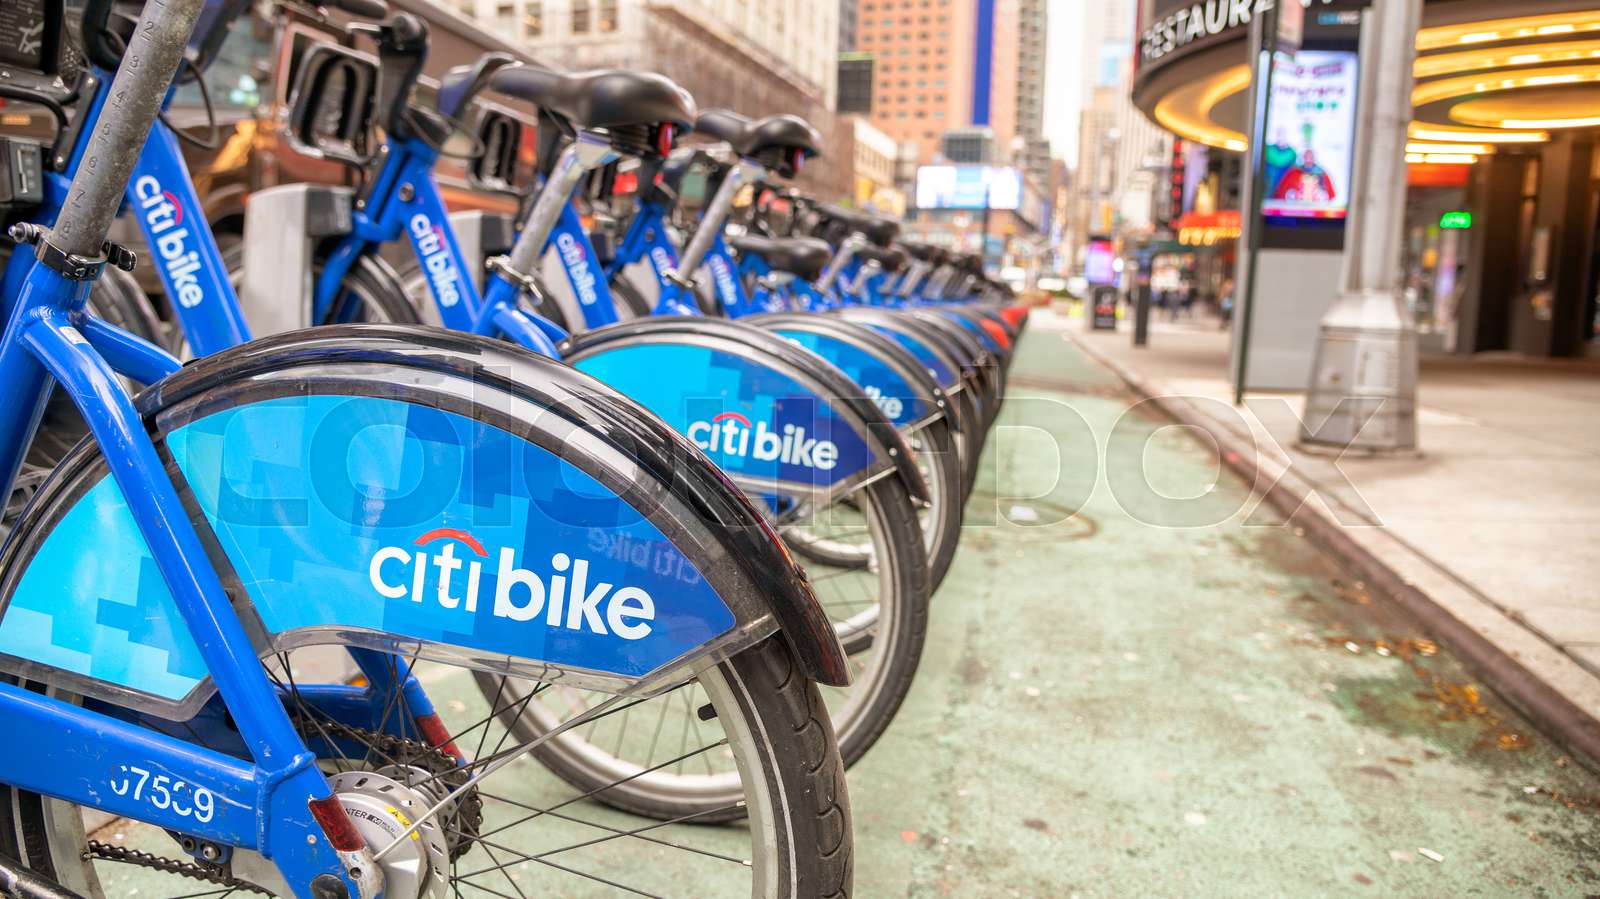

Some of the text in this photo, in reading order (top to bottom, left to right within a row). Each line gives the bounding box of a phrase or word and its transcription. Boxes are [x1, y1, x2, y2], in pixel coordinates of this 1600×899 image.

[135, 174, 203, 309] citi bike
[410, 213, 460, 308] citi bike
[687, 418, 839, 470] citi bike
[369, 541, 655, 640] citi bike
